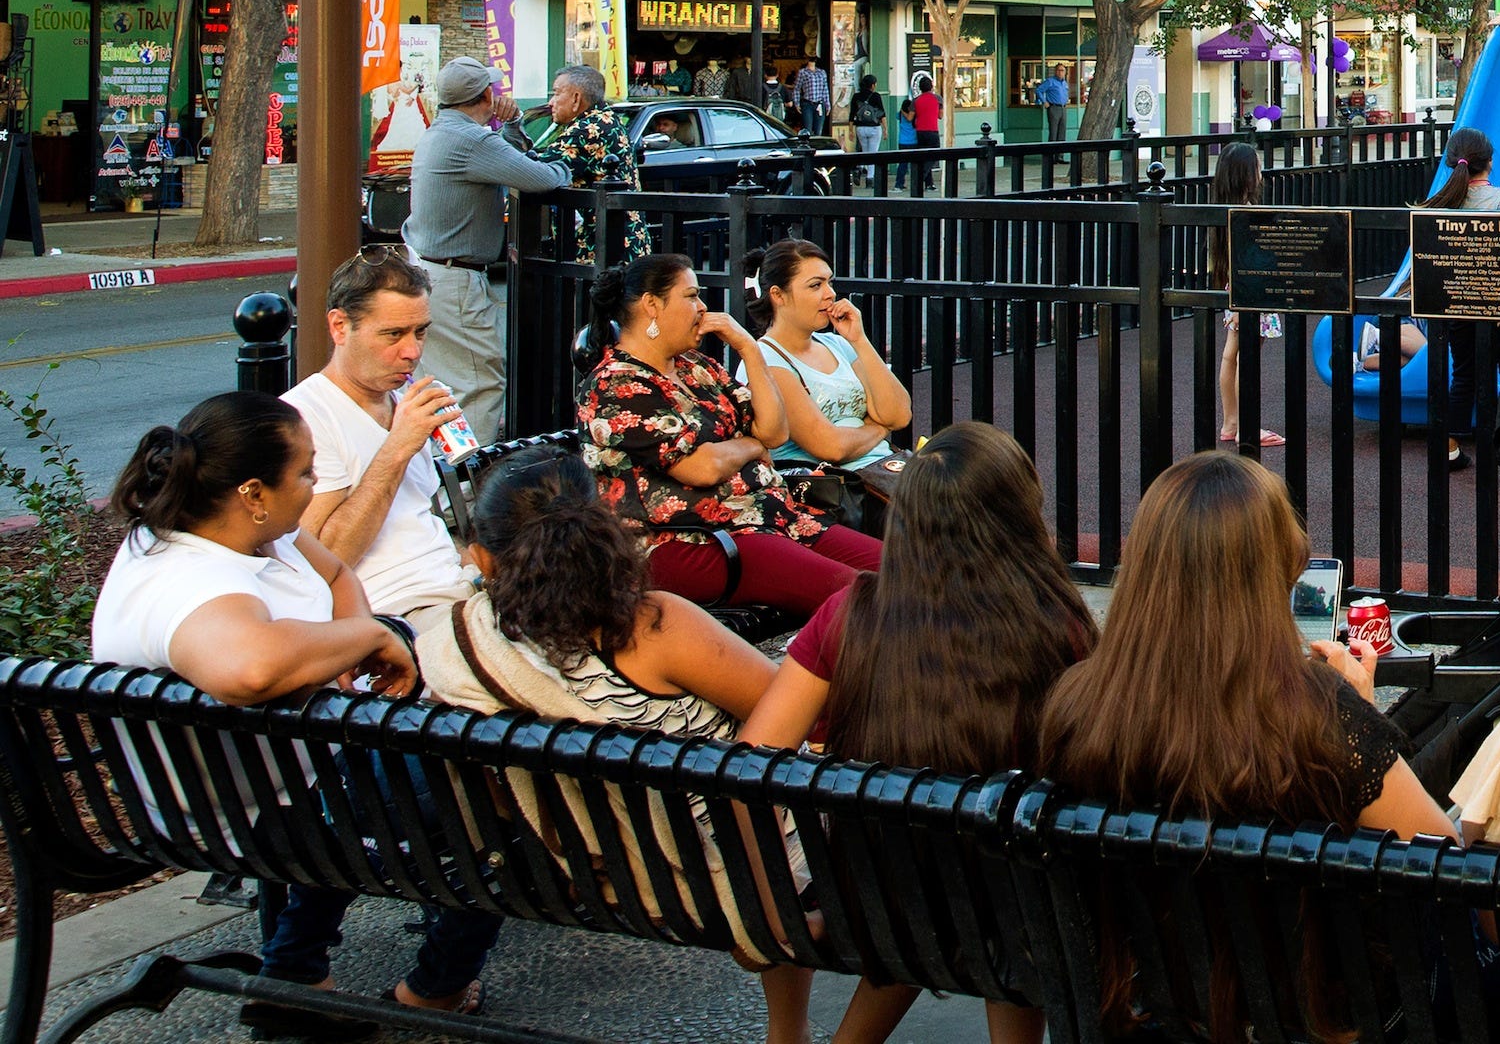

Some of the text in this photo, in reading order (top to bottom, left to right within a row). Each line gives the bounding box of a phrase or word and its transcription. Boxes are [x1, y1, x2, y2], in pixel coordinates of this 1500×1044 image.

[1217, 48, 1250, 56] metroPCS
[266, 92, 284, 164] OPEN
[1436, 219, 1467, 234] Tiny
[1471, 220, 1494, 233] Tot
[91, 270, 150, 289] 10918 A
